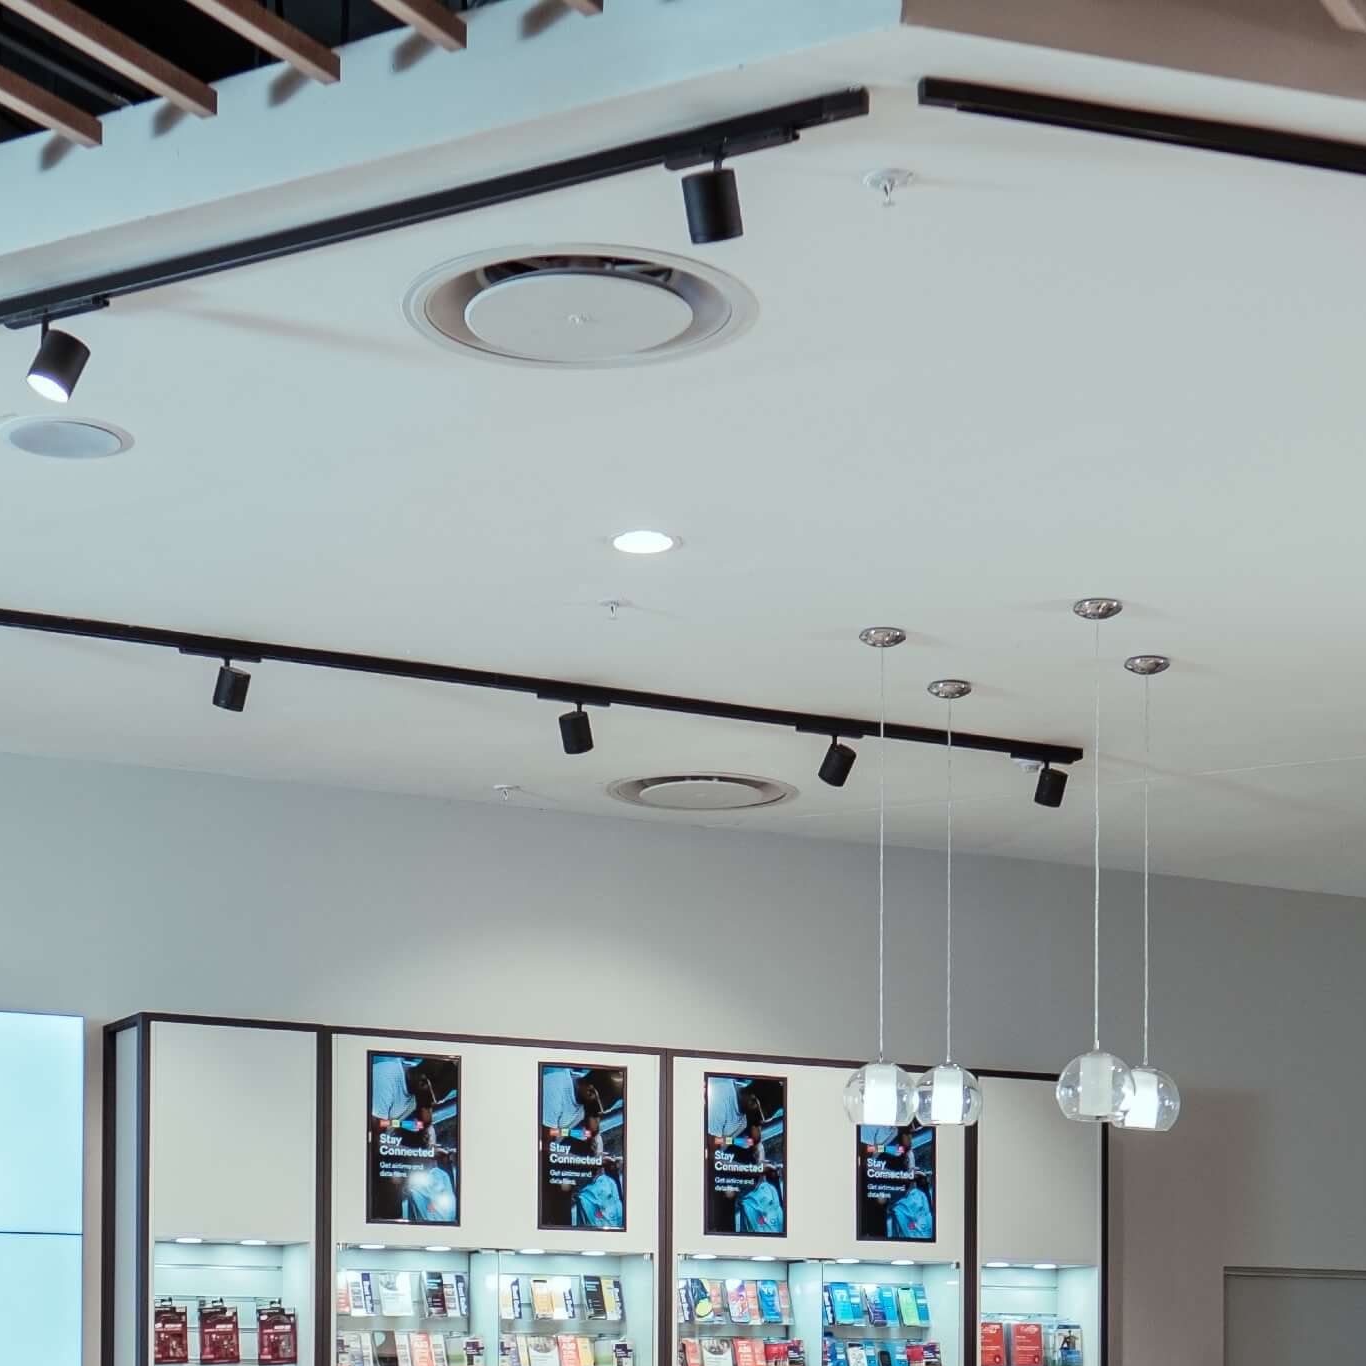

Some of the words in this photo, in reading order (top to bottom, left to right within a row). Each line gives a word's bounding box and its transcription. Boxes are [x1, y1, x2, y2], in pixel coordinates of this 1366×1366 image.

[379, 1133, 402, 1146] Stay
[379, 1145, 435, 1158] Connected
[549, 1142, 571, 1155] Stay
[549, 1153, 602, 1166] Connected
[715, 1150, 734, 1163] Stay
[715, 1161, 764, 1173] Connected
[866, 1158, 886, 1170] Stay
[866, 1169, 915, 1180] Connected
